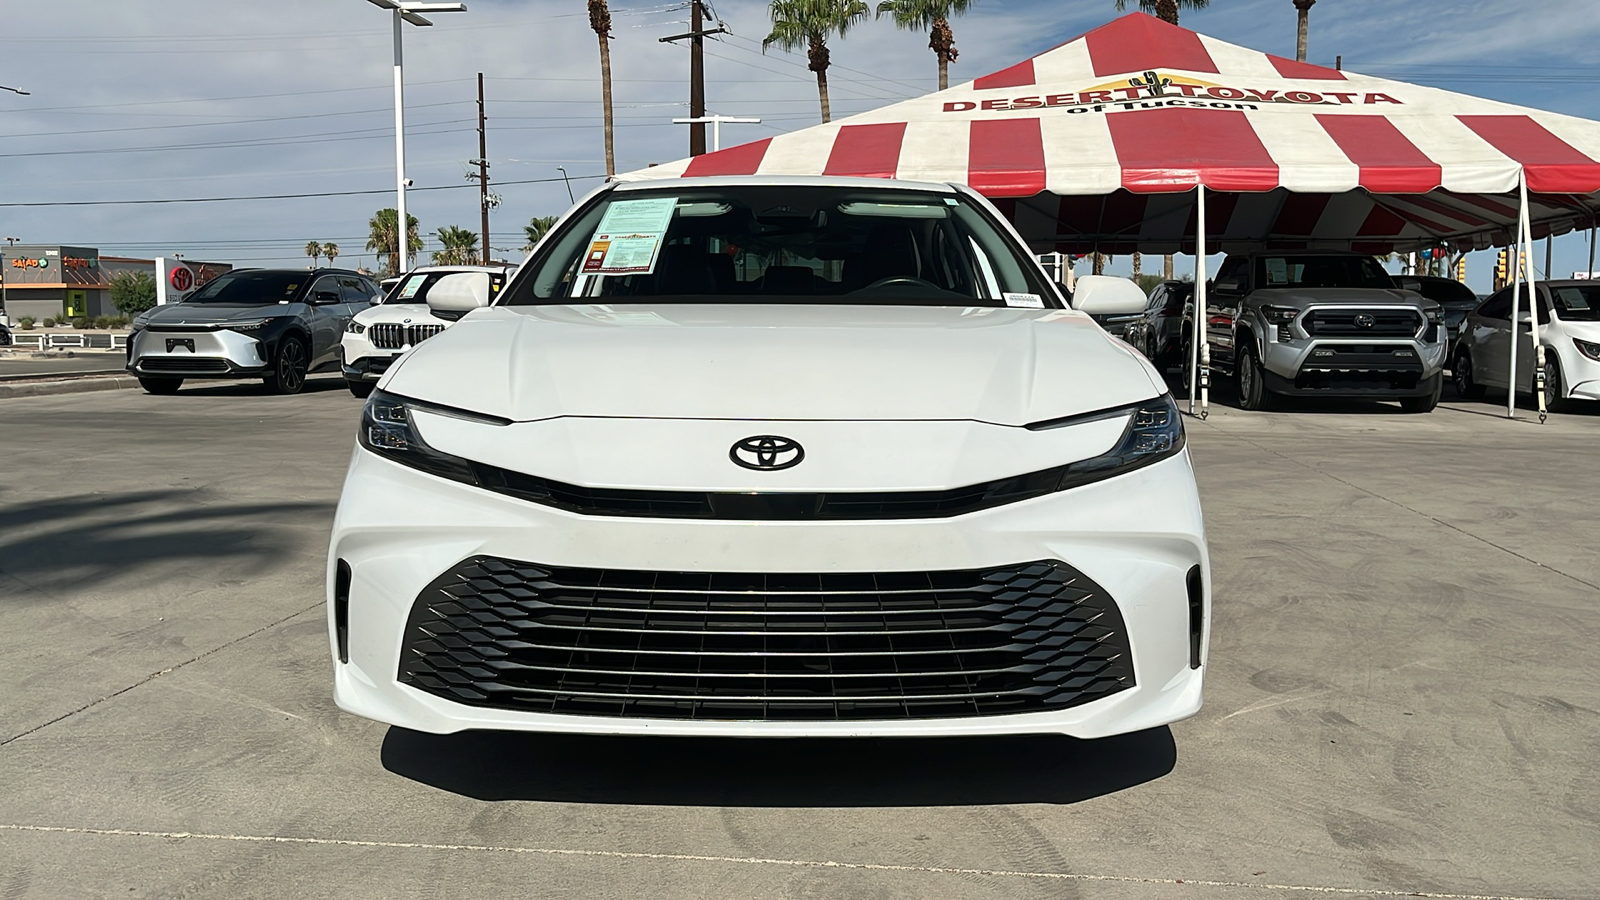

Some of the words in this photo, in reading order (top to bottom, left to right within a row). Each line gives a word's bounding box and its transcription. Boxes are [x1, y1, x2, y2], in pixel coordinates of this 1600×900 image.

[942, 86, 1148, 112] DESERT
[1169, 83, 1405, 104] TOYOTA
[1066, 104, 1106, 114] of
[1114, 99, 1259, 110] Tucson
[12, 257, 39, 269] SALAD
